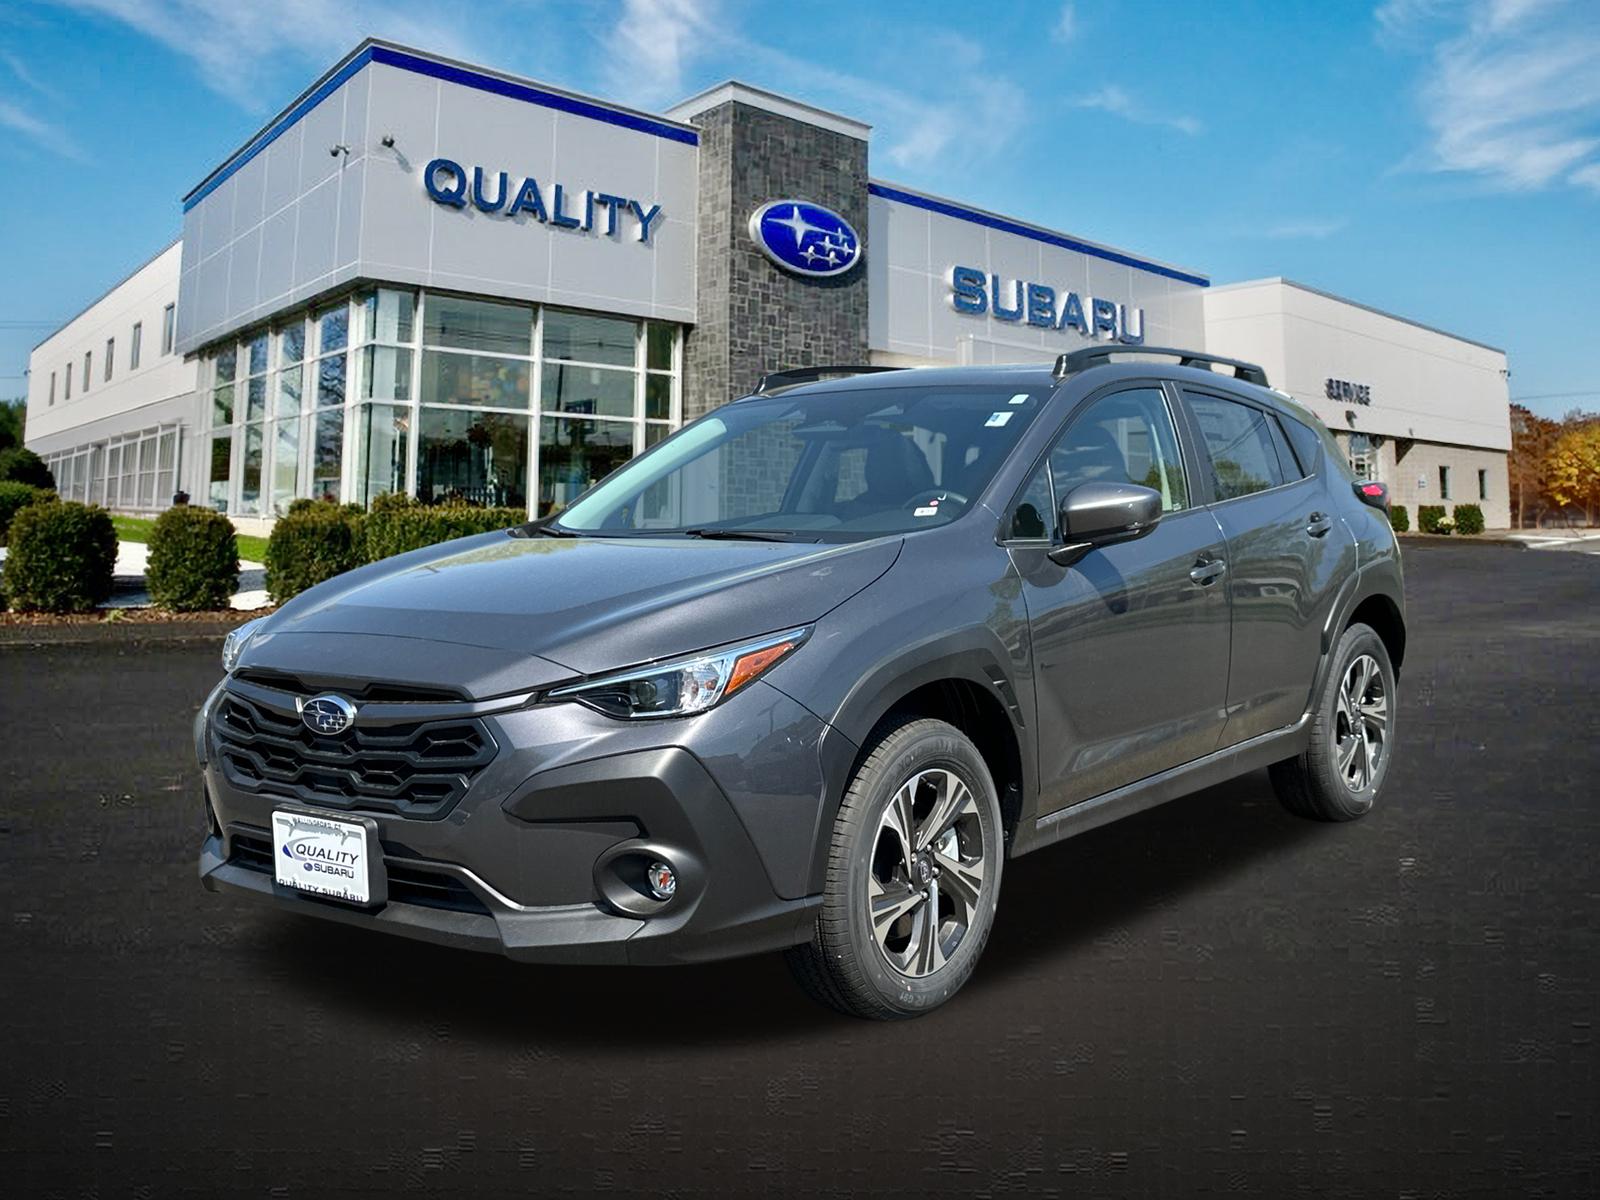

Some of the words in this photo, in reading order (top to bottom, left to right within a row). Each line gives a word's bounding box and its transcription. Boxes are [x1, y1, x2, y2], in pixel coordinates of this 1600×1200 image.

[423, 158, 662, 243] QUALITY
[947, 265, 1145, 346] SUBARU
[1324, 377, 1371, 406] SERVICE
[295, 843, 359, 865] QUALITY
[313, 863, 355, 879] SUBARU
[279, 877, 320, 894] QUALITY
[322, 887, 364, 903] SUBARU
